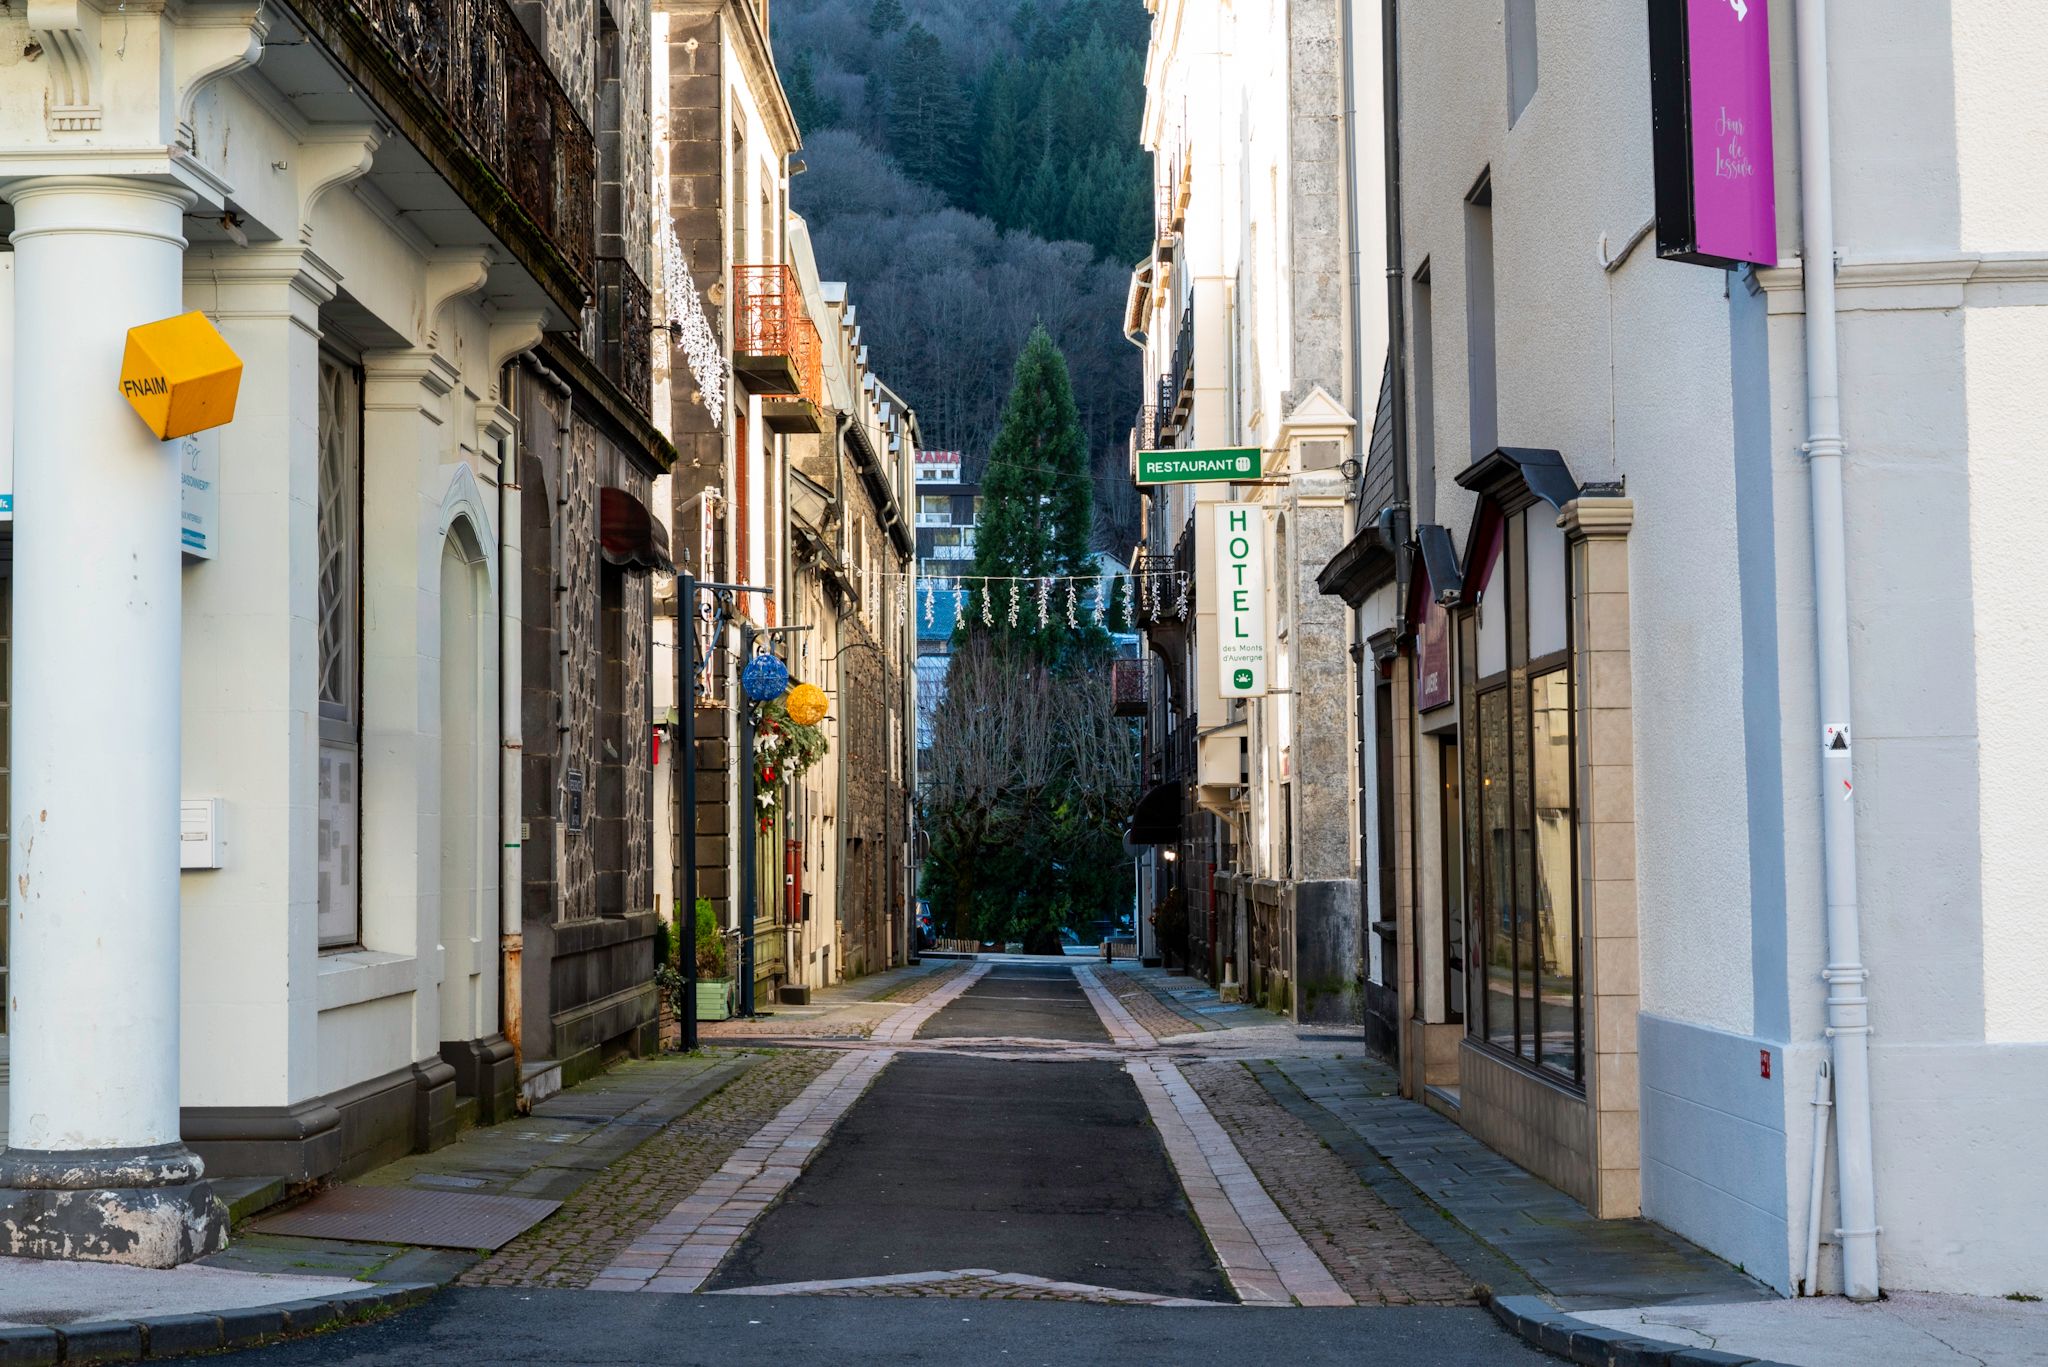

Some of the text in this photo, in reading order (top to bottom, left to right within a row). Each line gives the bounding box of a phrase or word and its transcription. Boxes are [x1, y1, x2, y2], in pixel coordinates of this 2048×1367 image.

[1728, 136, 1744, 158] de
[123, 376, 168, 398] FNAIM
[1146, 459, 1234, 474] RESTAURANT
[1229, 510, 1250, 638] HOTEL
[1239, 644, 1263, 652] Monts
[1223, 654, 1263, 662] d'Auvergne
